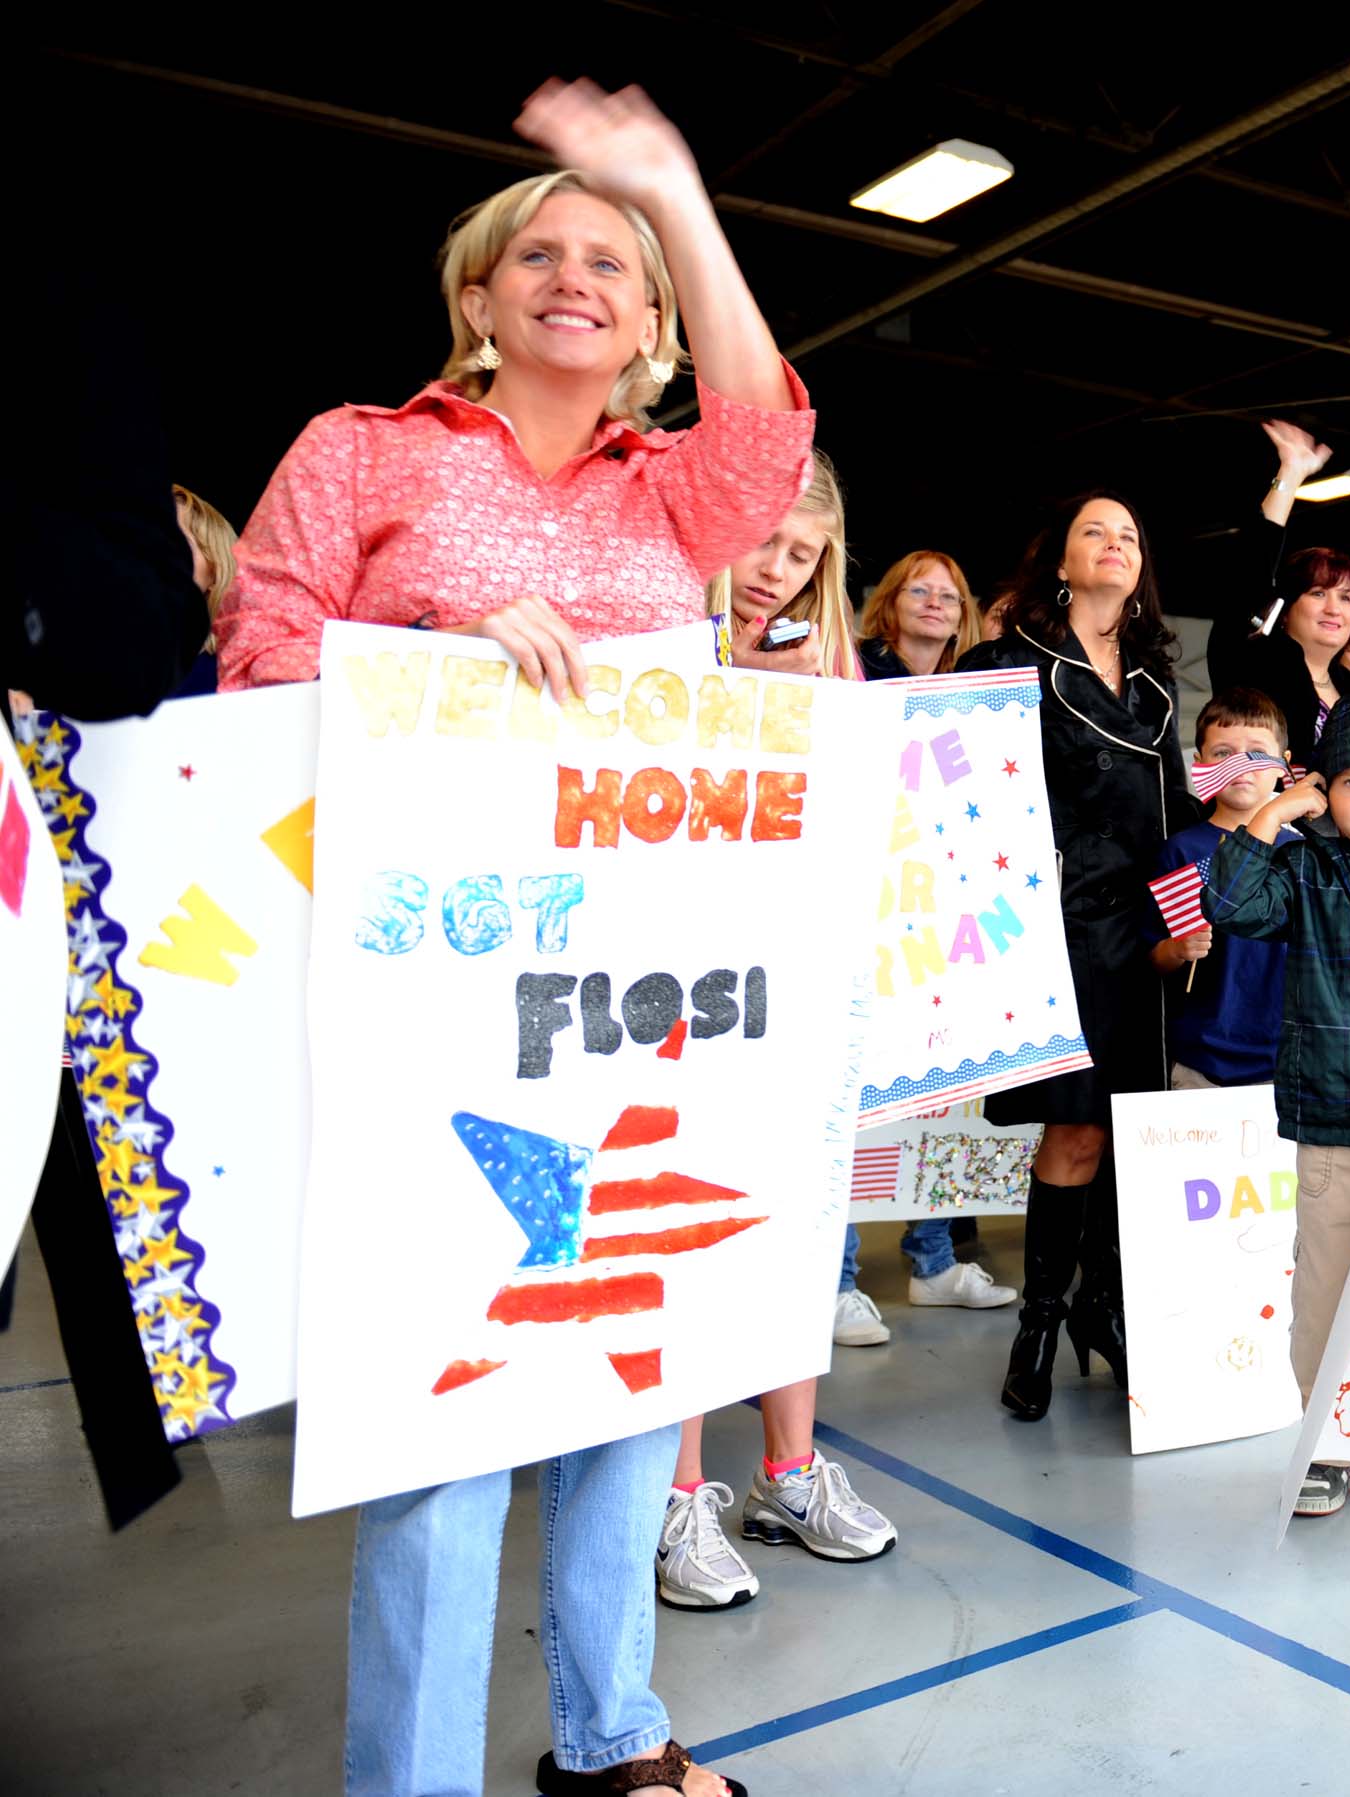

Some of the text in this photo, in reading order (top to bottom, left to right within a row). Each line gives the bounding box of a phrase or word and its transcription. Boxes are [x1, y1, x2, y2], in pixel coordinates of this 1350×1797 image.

[341, 651, 815, 755] WELCOME
[553, 762, 808, 849] HOME
[353, 869, 586, 956] SGT
[1136, 1122, 1224, 1148] Welcome
